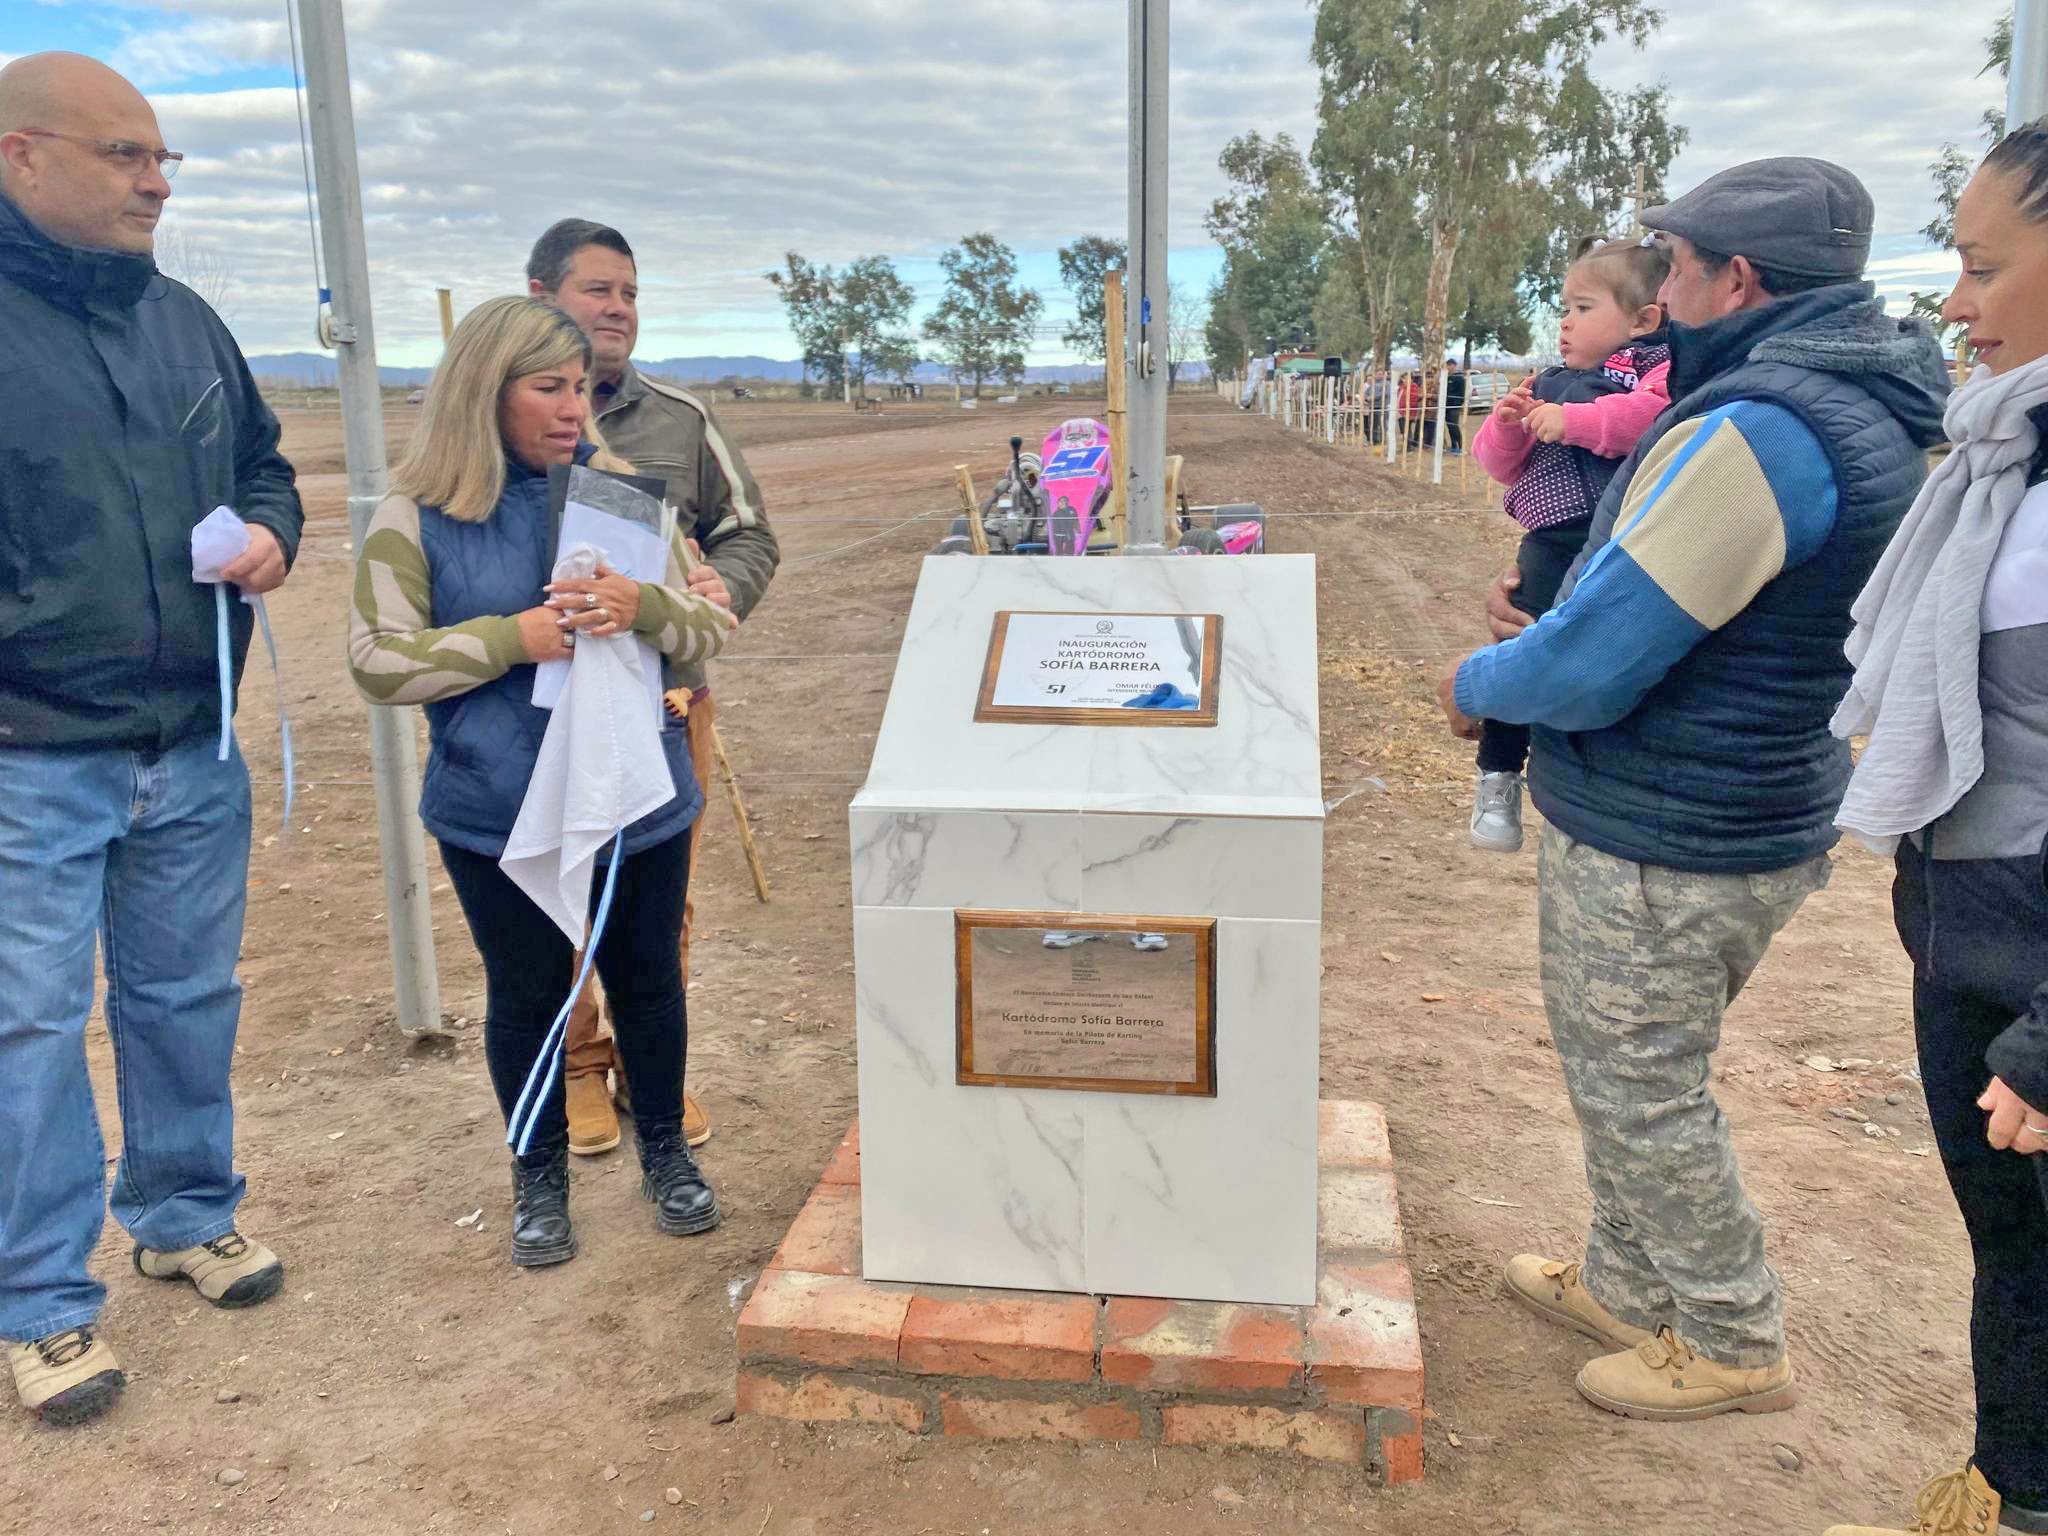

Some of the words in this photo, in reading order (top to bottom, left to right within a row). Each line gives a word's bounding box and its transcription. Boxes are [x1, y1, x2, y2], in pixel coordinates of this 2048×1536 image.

[1041, 445, 1110, 475] 51
[1058, 640, 1147, 649] INAUGURACIÓN
[1058, 650, 1145, 660] KARTÓDROMO
[1039, 659, 1085, 671] SOFÍA
[1089, 661, 1161, 672] BARRERA
[1046, 684, 1067, 694] 51
[1002, 1012, 1077, 1024] Kartódromo
[1081, 1014, 1111, 1025] Sofía
[1116, 1016, 1164, 1027] Barrera
[1117, 1032, 1143, 1040] Karting
